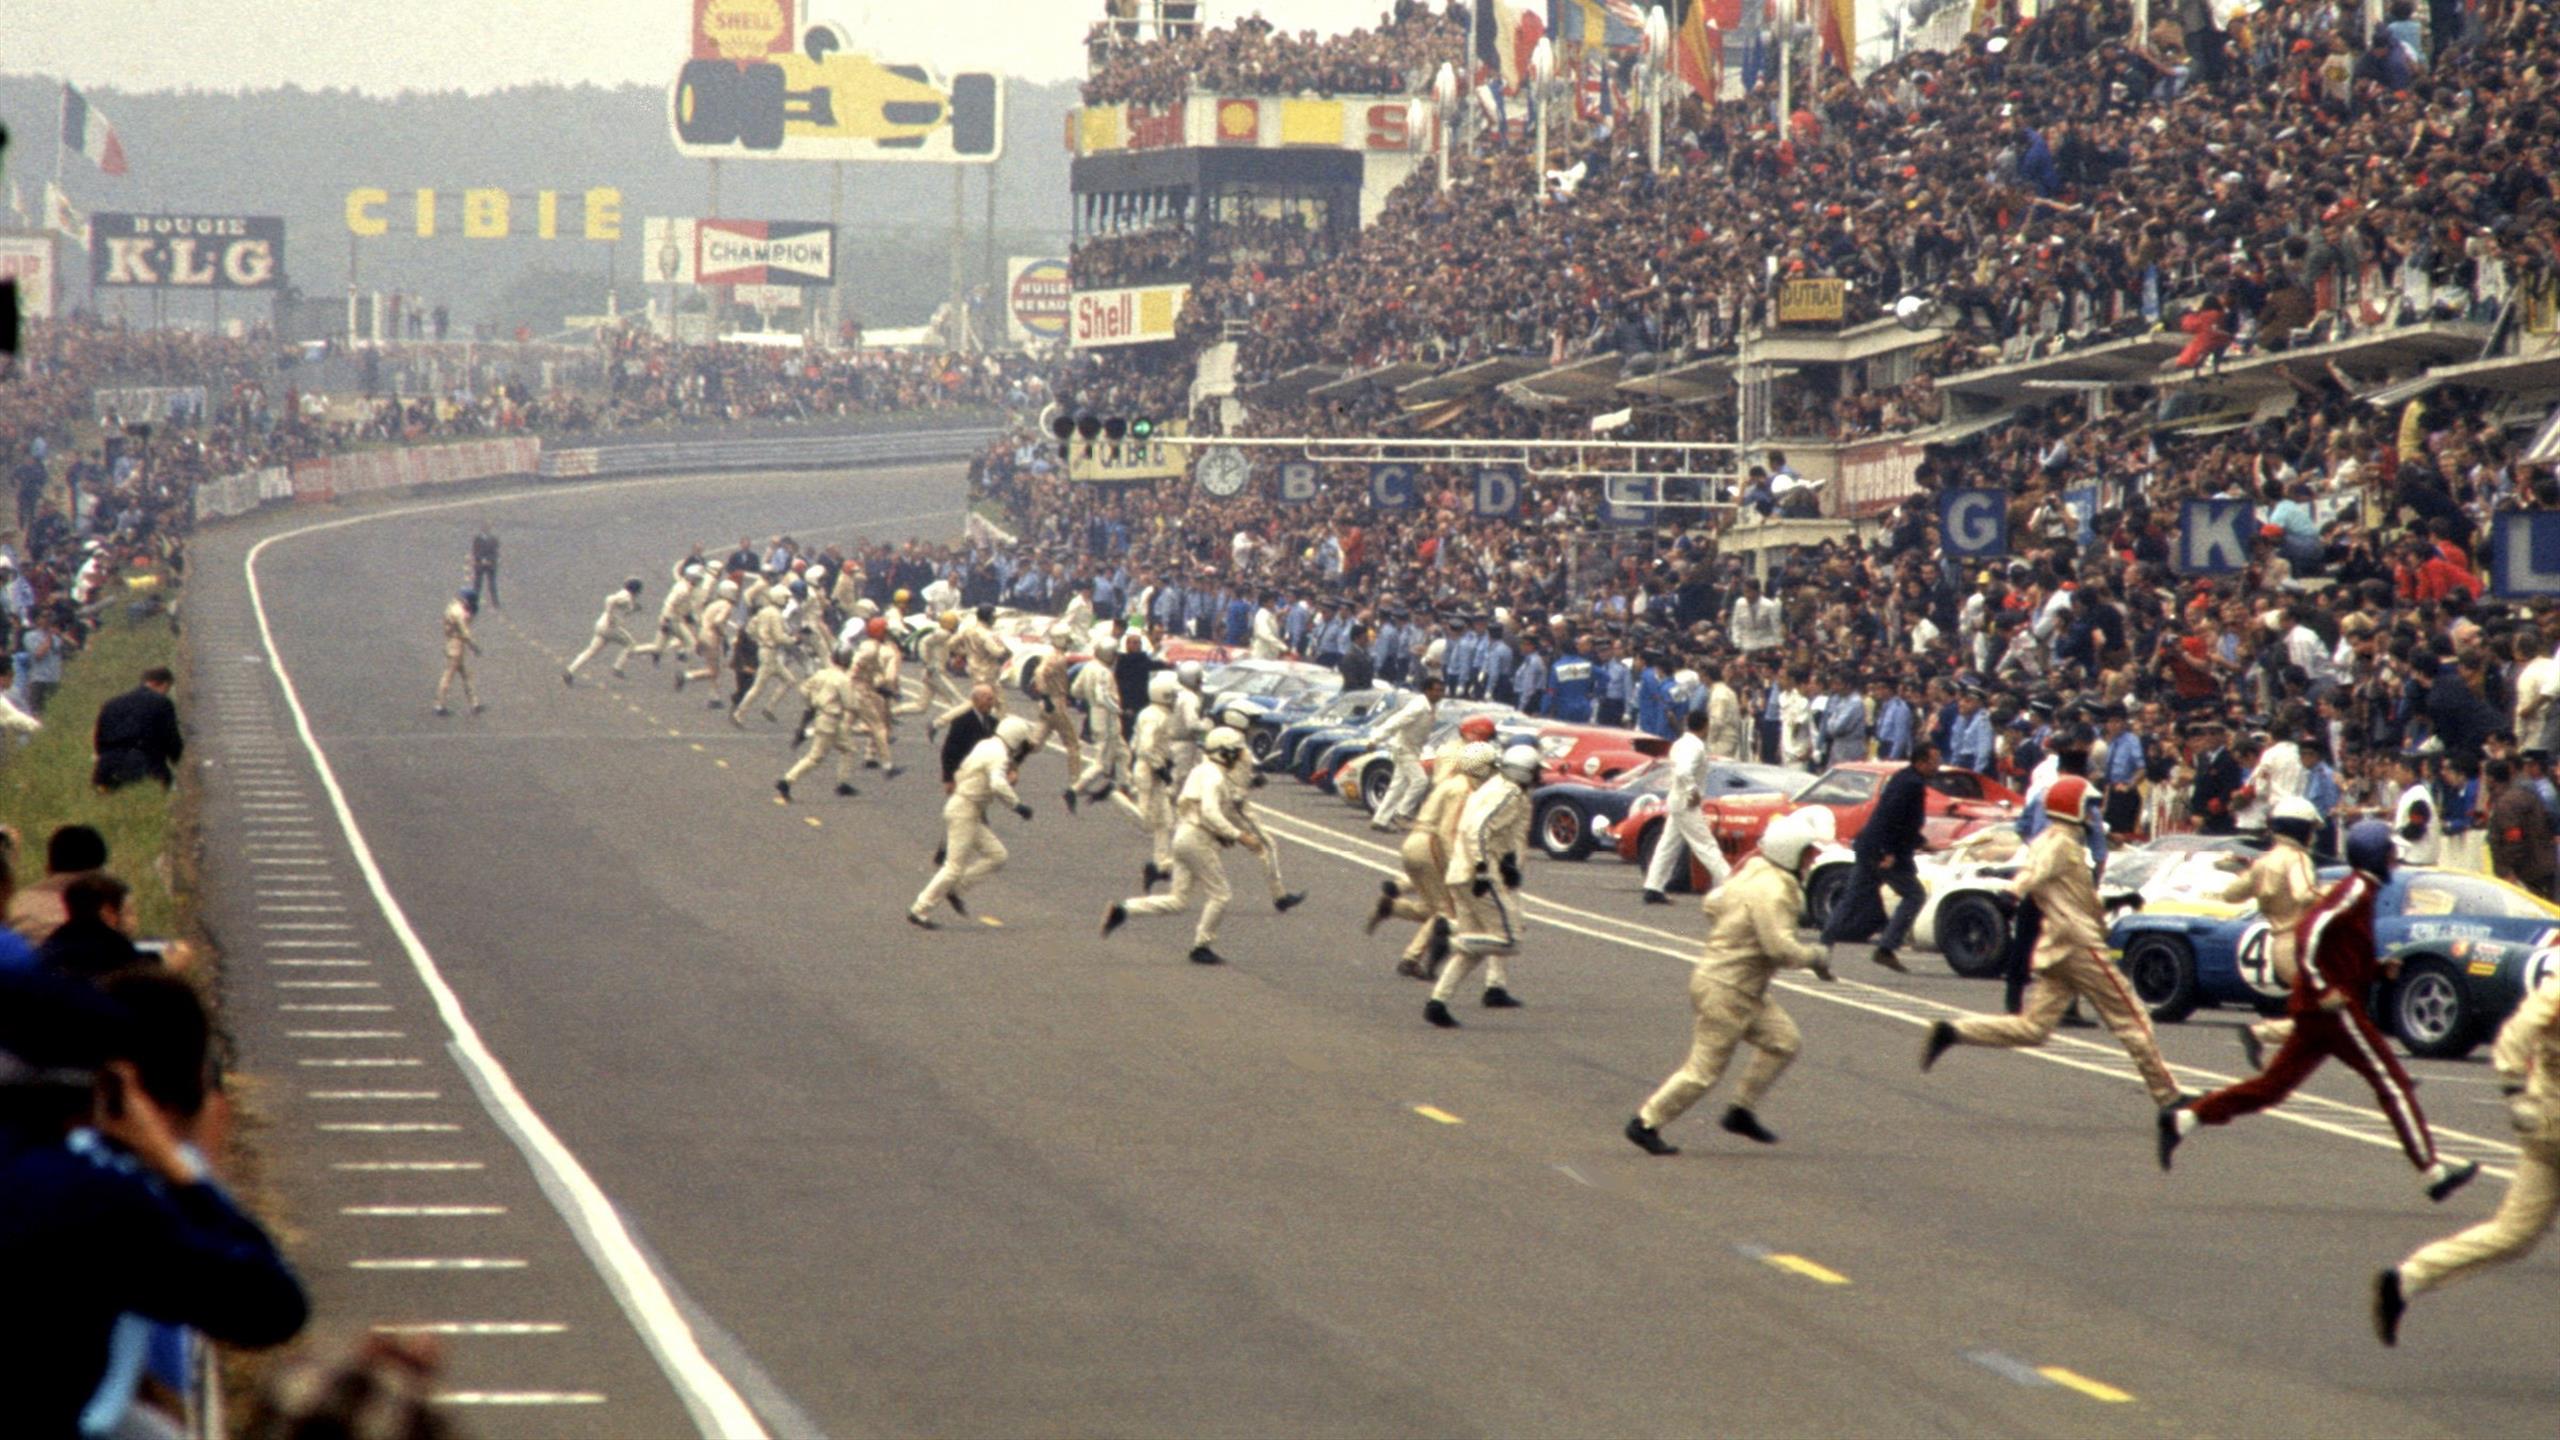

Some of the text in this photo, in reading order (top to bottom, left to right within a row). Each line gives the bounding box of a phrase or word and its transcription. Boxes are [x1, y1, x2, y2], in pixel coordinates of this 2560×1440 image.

[134, 217, 248, 236] BOUGIE
[709, 241, 823, 263] CHAMPION
[1014, 299, 1067, 311] RENAU
[1078, 292, 1133, 339] Shell
[1283, 464, 1315, 499] B
[1373, 466, 1406, 504] C
[1478, 470, 1517, 514] D
[1610, 476, 1648, 520] E
[1948, 493, 1998, 550] G
[2190, 502, 2247, 568] K
[2507, 516, 2560, 593] L
[2241, 928, 2272, 985] 4
